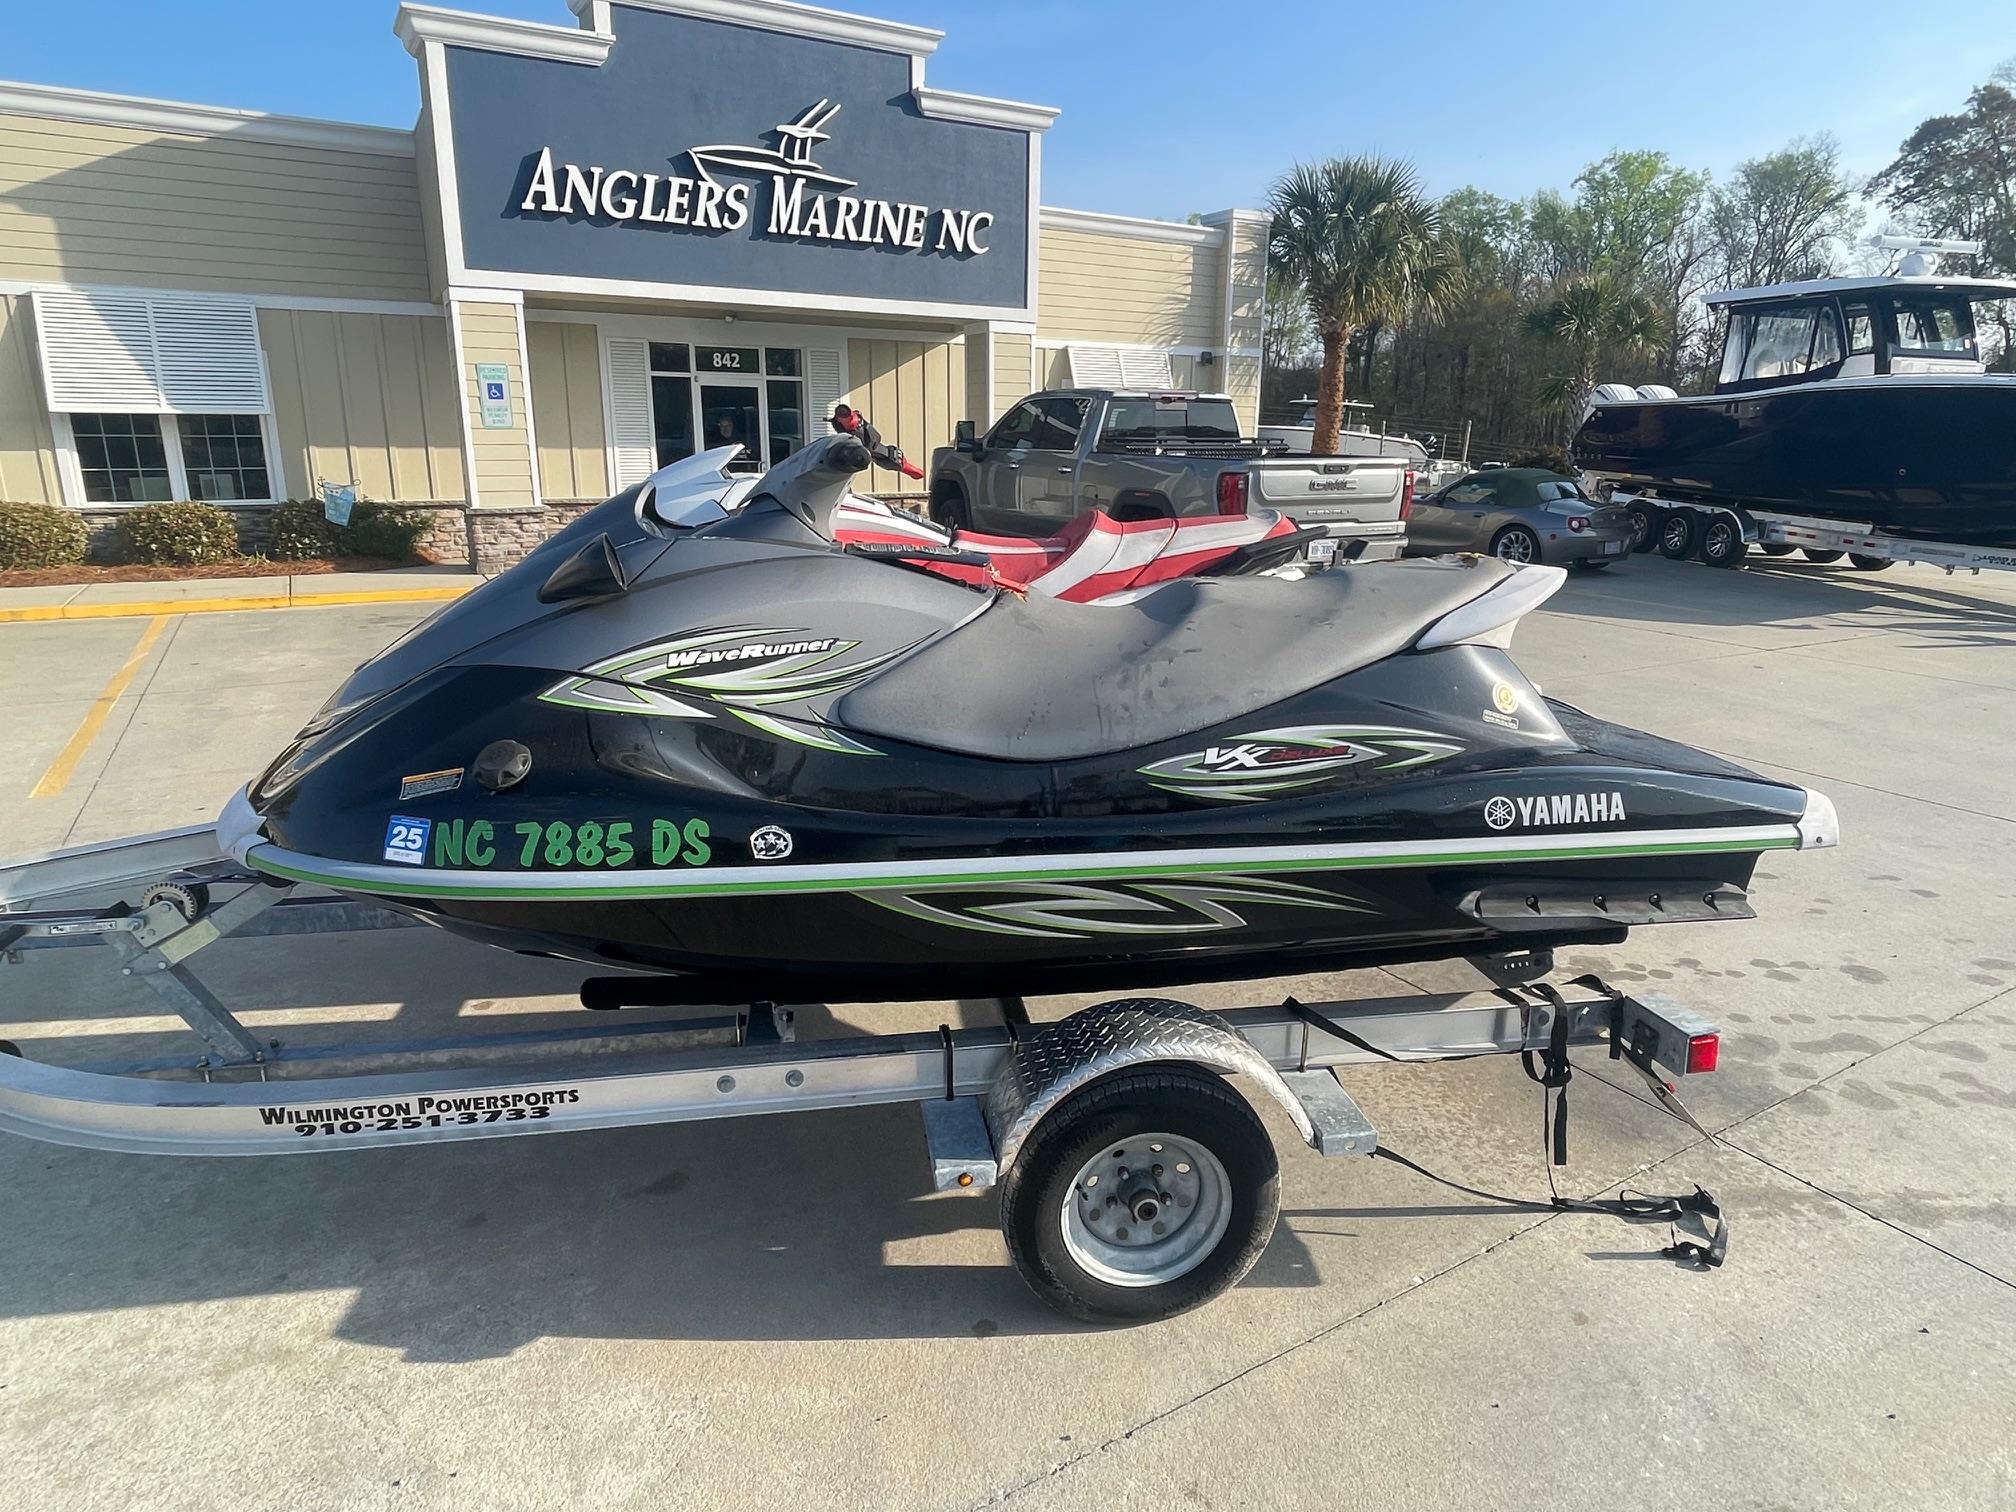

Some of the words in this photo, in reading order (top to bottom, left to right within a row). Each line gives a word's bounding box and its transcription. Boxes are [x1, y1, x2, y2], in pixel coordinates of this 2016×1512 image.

[521, 146, 749, 231] ANGLERS
[767, 175, 929, 248] MARINE
[935, 208, 995, 255] NC
[712, 352, 741, 368] 842
[1309, 478, 1359, 491] GMC
[1306, 508, 1350, 516] DENALI
[667, 637, 840, 669] WaveRunner
[1204, 743, 1273, 771] VX
[1516, 791, 1626, 827] YAMAHA
[389, 825, 423, 850] 25
[434, 818, 496, 867] NC
[515, 820, 635, 868] 7885
[652, 818, 712, 867] DS
[259, 1102, 411, 1125] WILMINGTON
[418, 1089, 580, 1117] POWERSPORTS
[294, 1105, 552, 1138] 910-251-3733
